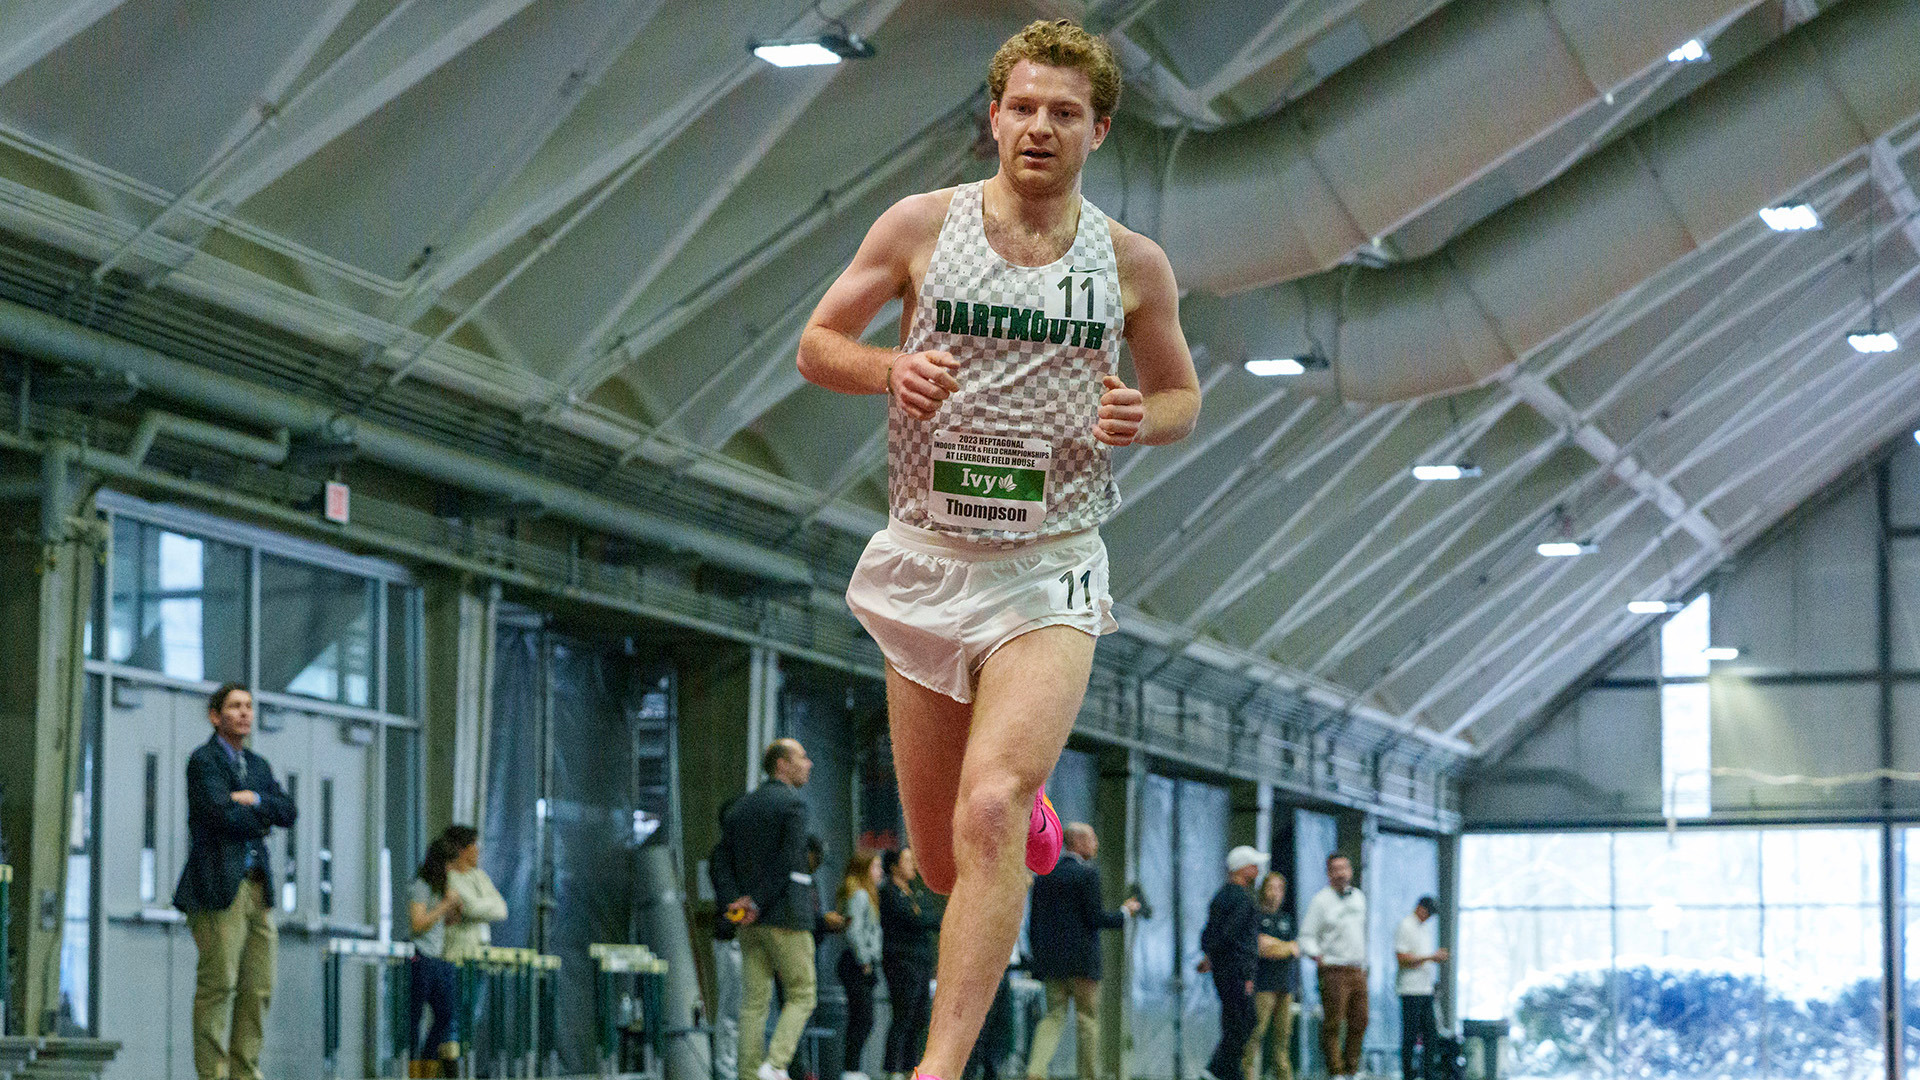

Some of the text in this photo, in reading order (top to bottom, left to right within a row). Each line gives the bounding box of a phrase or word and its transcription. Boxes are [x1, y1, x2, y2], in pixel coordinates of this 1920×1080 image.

[1057, 276, 1094, 320] 11
[935, 300, 1106, 349] DARTMOUTH
[934, 441, 956, 450] INDOOR
[957, 444, 976, 452] TRACK
[983, 446, 999, 454] FIELD
[999, 448, 1050, 459] CHAMPIONSHIPS
[959, 435, 1024, 449] 2023 HEPTAGONAL
[945, 451, 1036, 468] AT LEVERONE FIELD HOUSE
[960, 467, 998, 494] Ivy
[946, 498, 1027, 522] Thompson
[1059, 570, 1093, 610] 11
